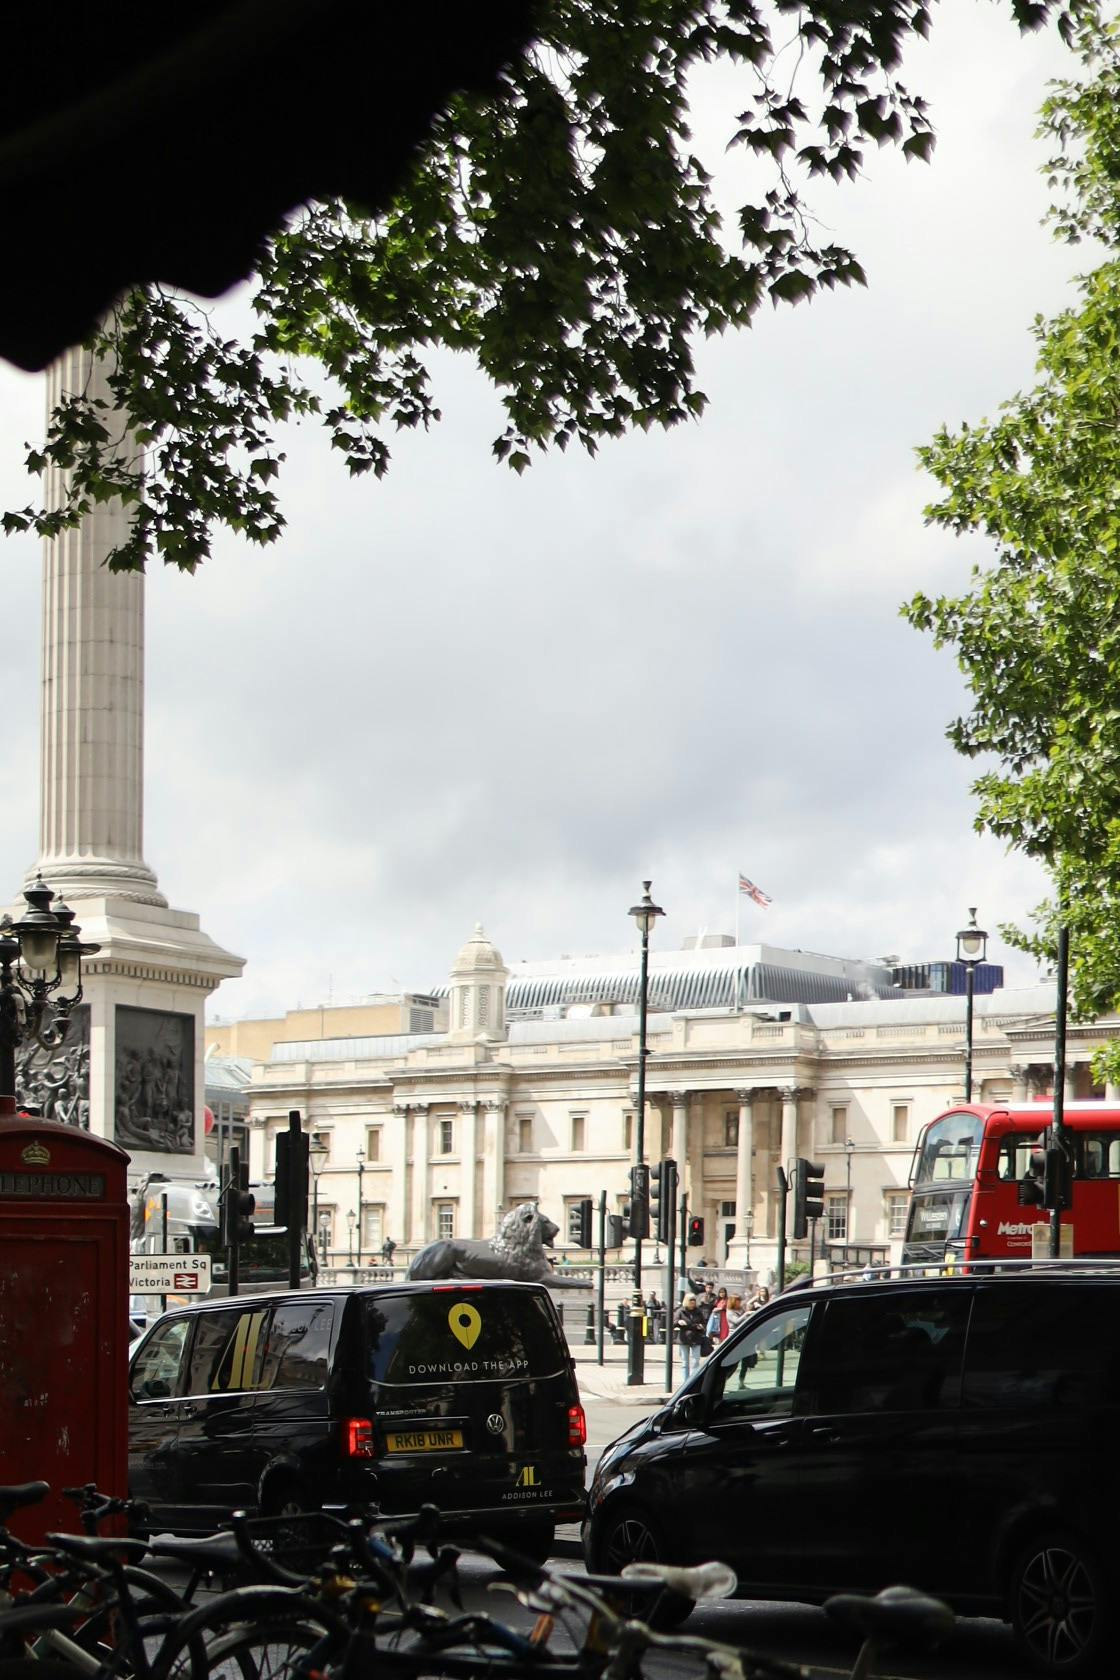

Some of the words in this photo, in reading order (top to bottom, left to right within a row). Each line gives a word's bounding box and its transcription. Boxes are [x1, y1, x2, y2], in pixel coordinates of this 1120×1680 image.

[997, 1221, 1037, 1236] Metro
[192, 1259, 207, 1271] Sq
[408, 1362, 478, 1375] DOWNLOAD
[482, 1360, 504, 1370] THE
[508, 1360, 529, 1370] APP
[395, 1433, 425, 1449] RK18
[429, 1432, 455, 1447] UNR
[502, 1491, 537, 1500] ADDISON
[540, 1490, 553, 1498] LEE
